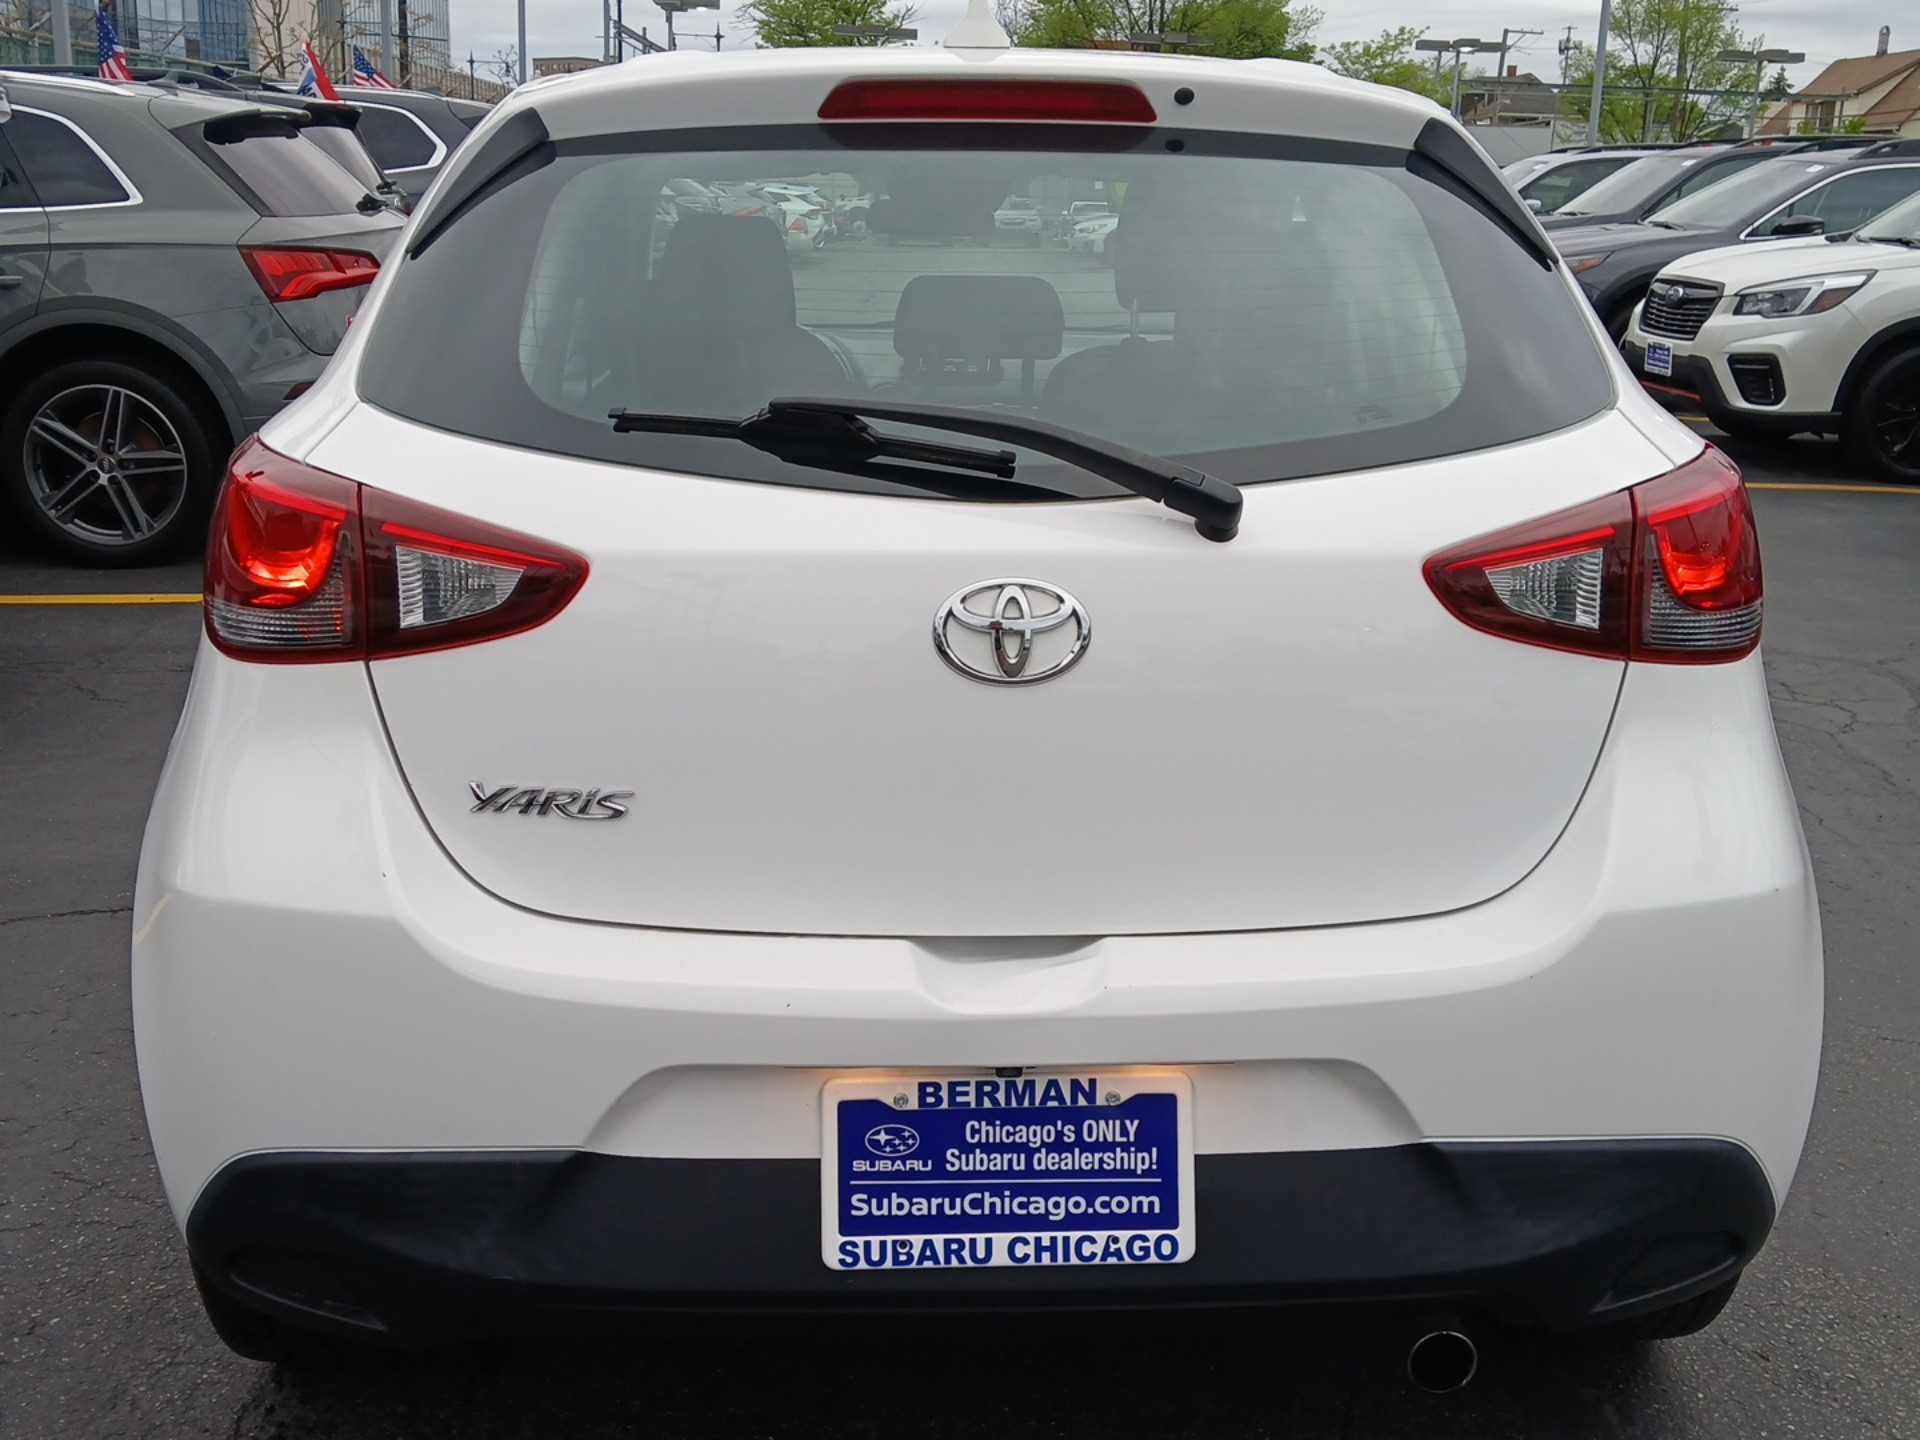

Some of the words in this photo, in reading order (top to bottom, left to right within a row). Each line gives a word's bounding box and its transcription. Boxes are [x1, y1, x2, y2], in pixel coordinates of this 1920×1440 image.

[469, 781, 635, 819] YARIS
[918, 1078, 1097, 1109] BERMAN
[965, 1119, 1076, 1148] Chicago's
[1083, 1119, 1140, 1142] ONLY
[852, 1159, 932, 1172] SUBARU
[946, 1148, 1026, 1172] Subaru
[1033, 1147, 1158, 1175] dealership!
[850, 1190, 1161, 1221] SubaruChicago.com
[838, 1237, 994, 1269] SUBARU
[1007, 1233, 1180, 1264] CHICAGO
